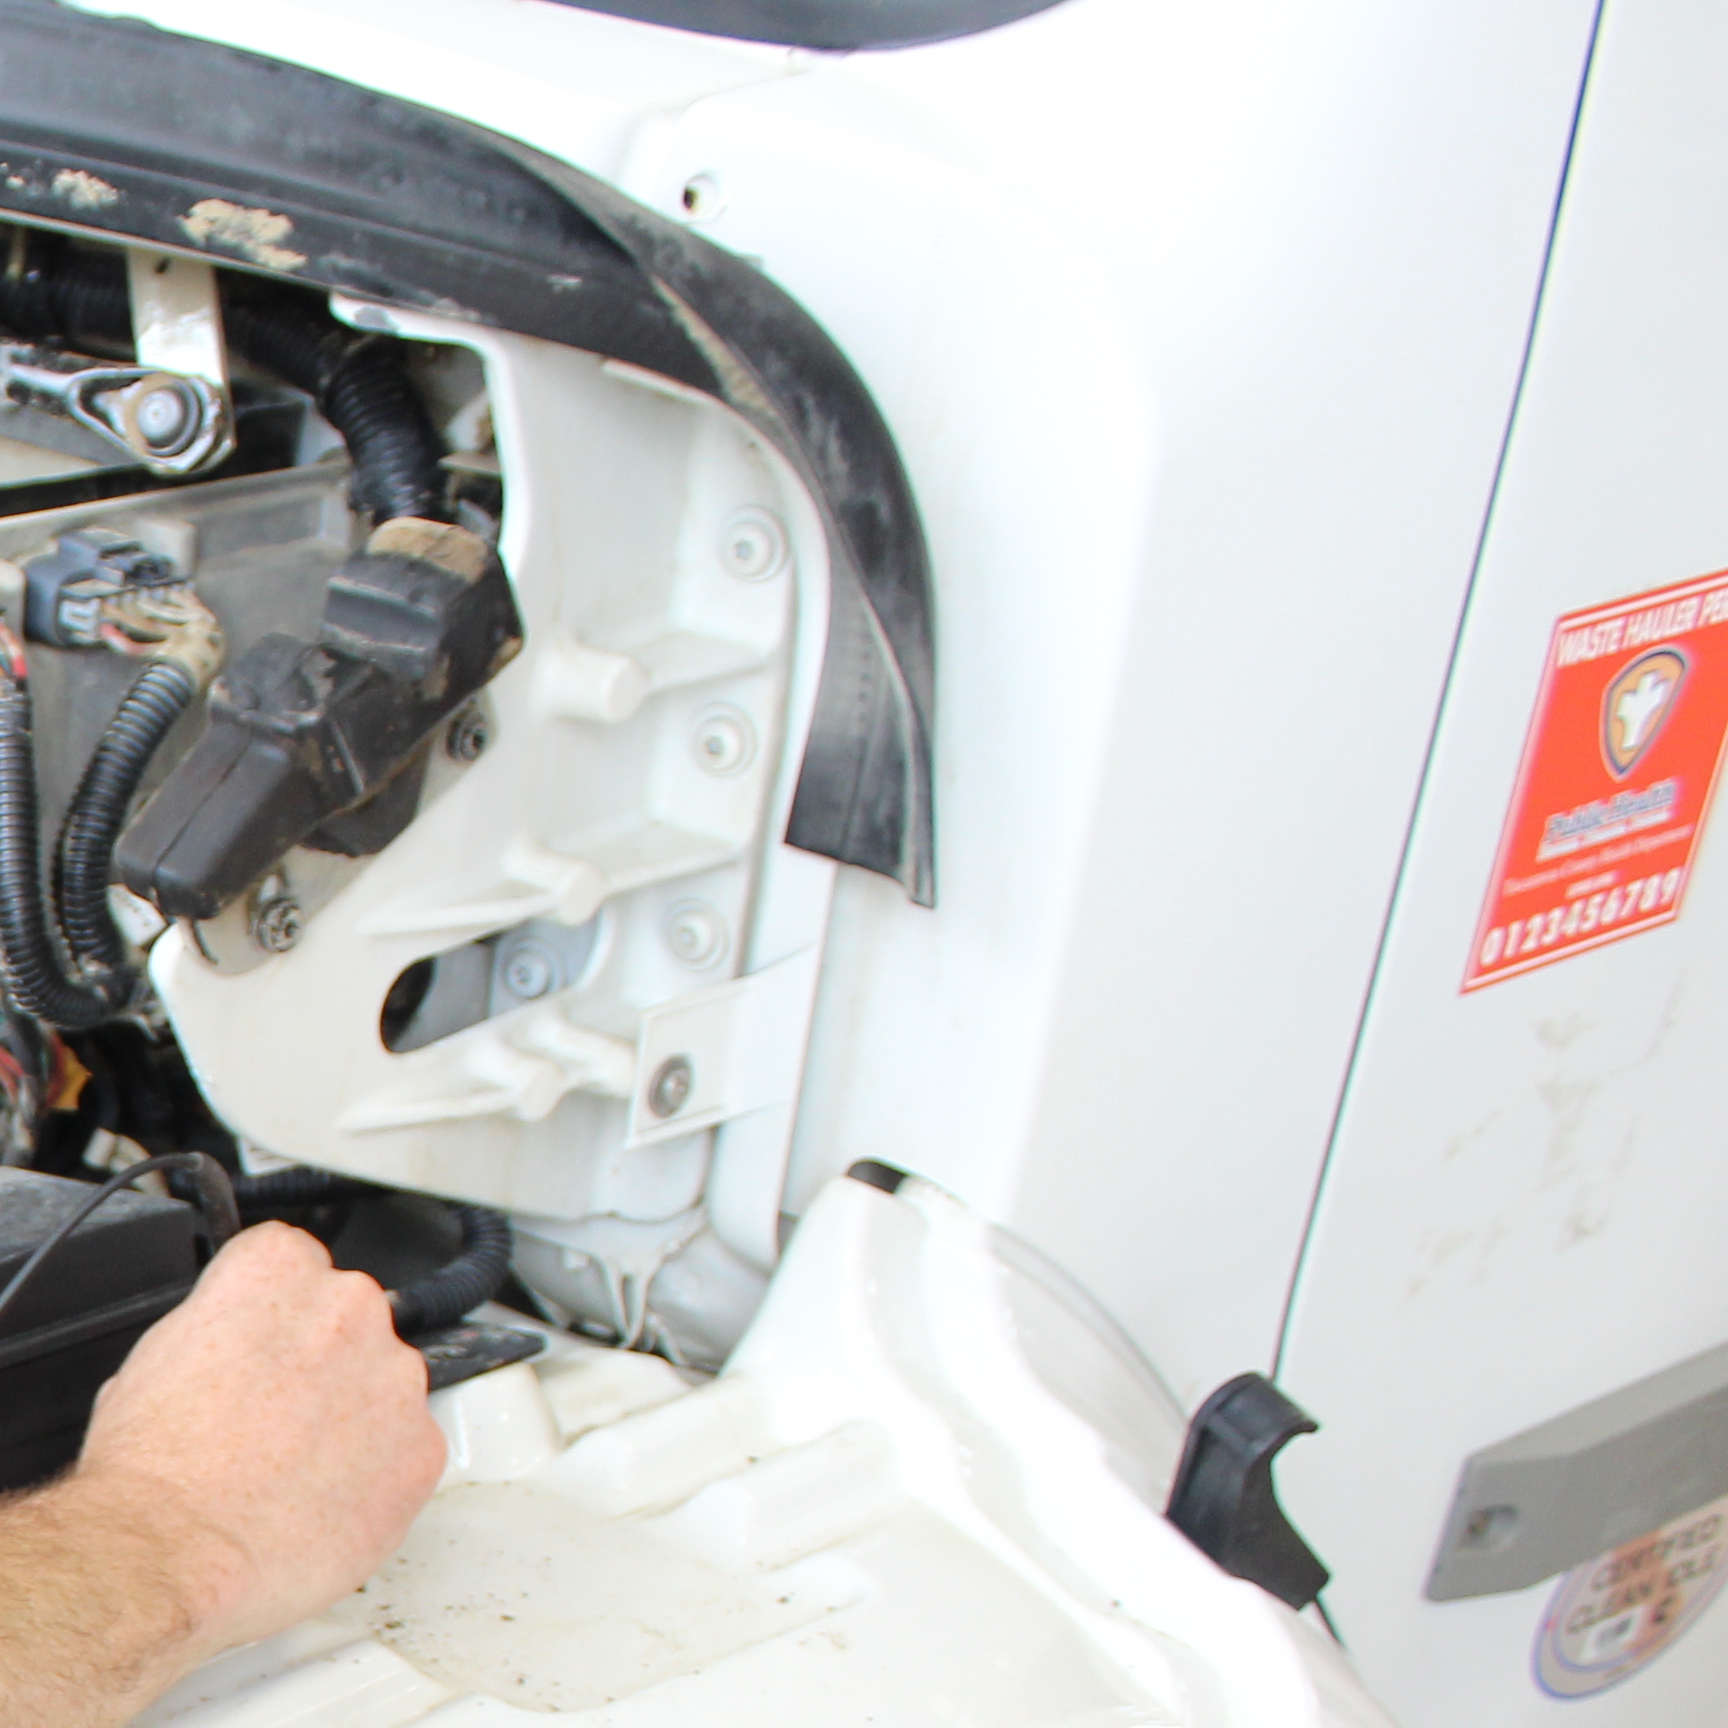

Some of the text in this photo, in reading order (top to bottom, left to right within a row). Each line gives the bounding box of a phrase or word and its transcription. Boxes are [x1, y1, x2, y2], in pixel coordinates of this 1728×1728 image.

[1556, 616, 1626, 668] WASTE
[1622, 596, 1701, 649] HAULER
[1480, 867, 1682, 968] 0123456789
